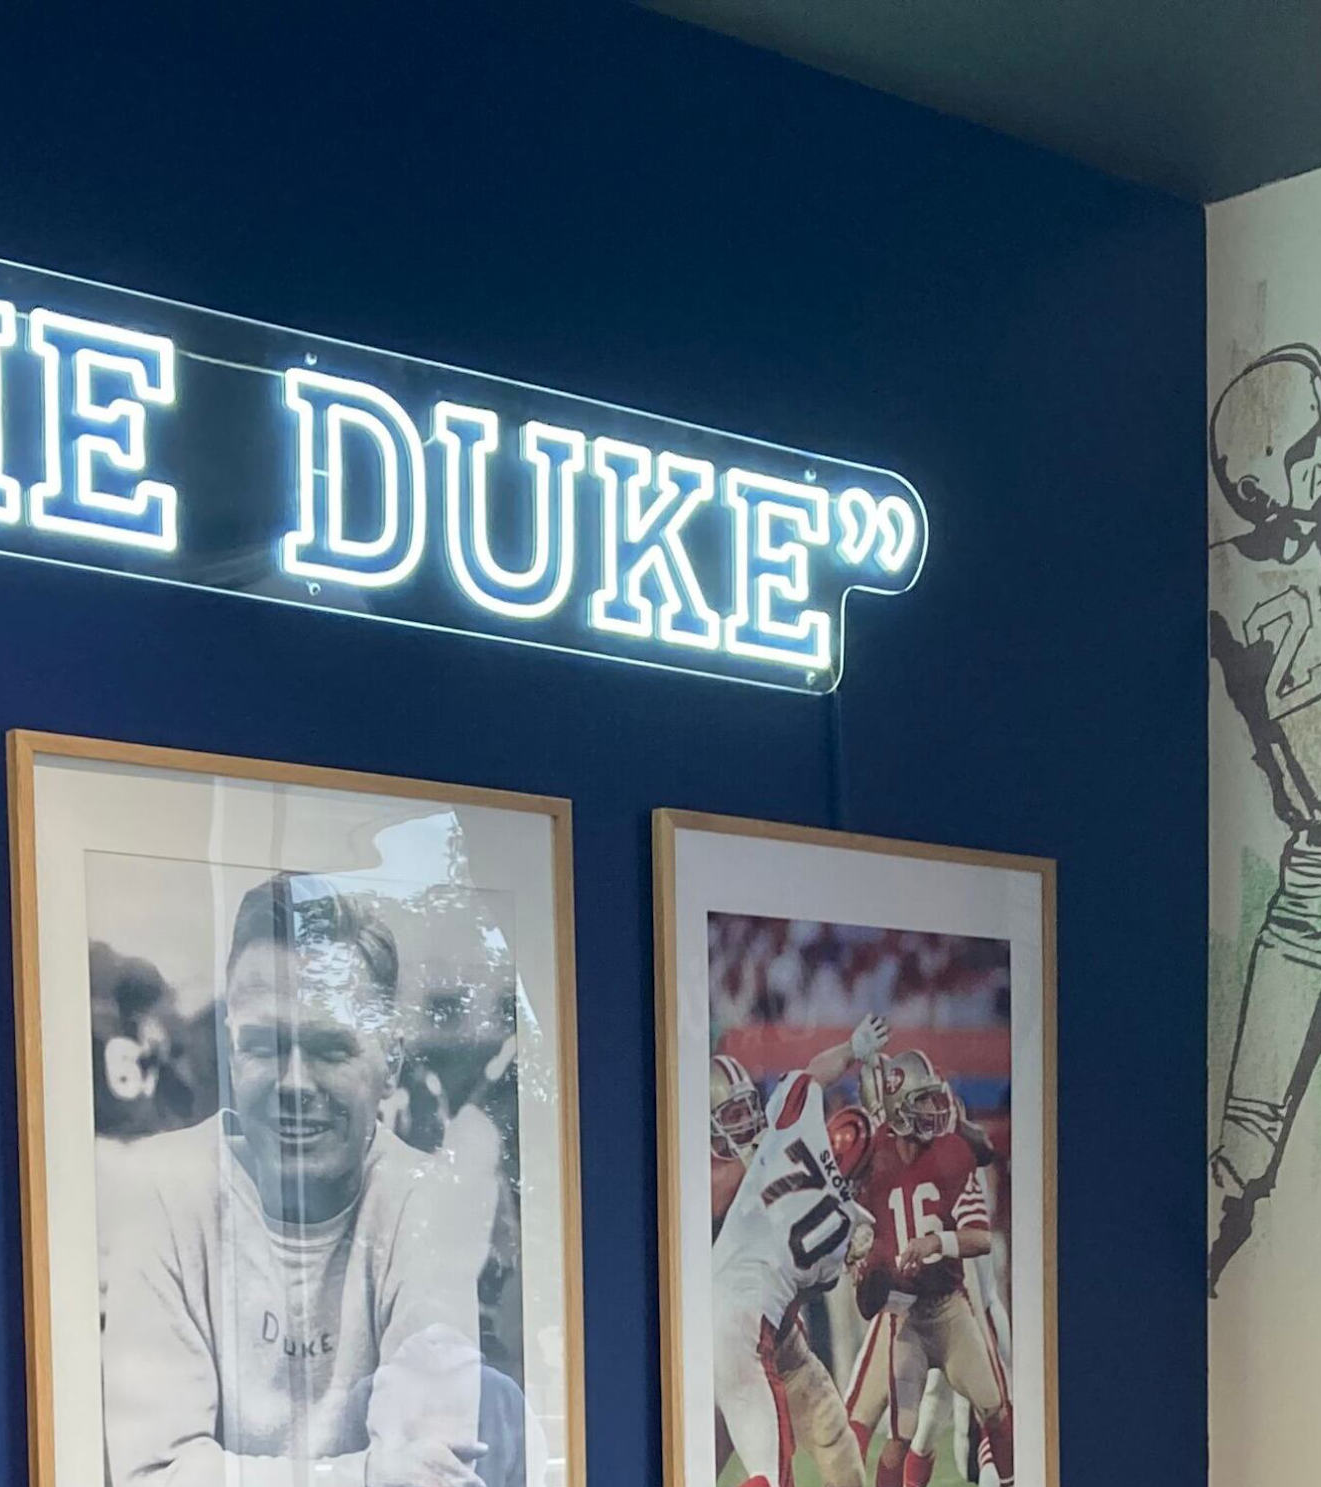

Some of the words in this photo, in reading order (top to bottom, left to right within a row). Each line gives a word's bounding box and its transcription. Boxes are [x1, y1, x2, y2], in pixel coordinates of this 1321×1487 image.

[278, 365, 918, 671] DUKE”
[761, 1137, 852, 1270] 70
[888, 1181, 944, 1273] 16
[262, 1310, 334, 1359] DUKE
